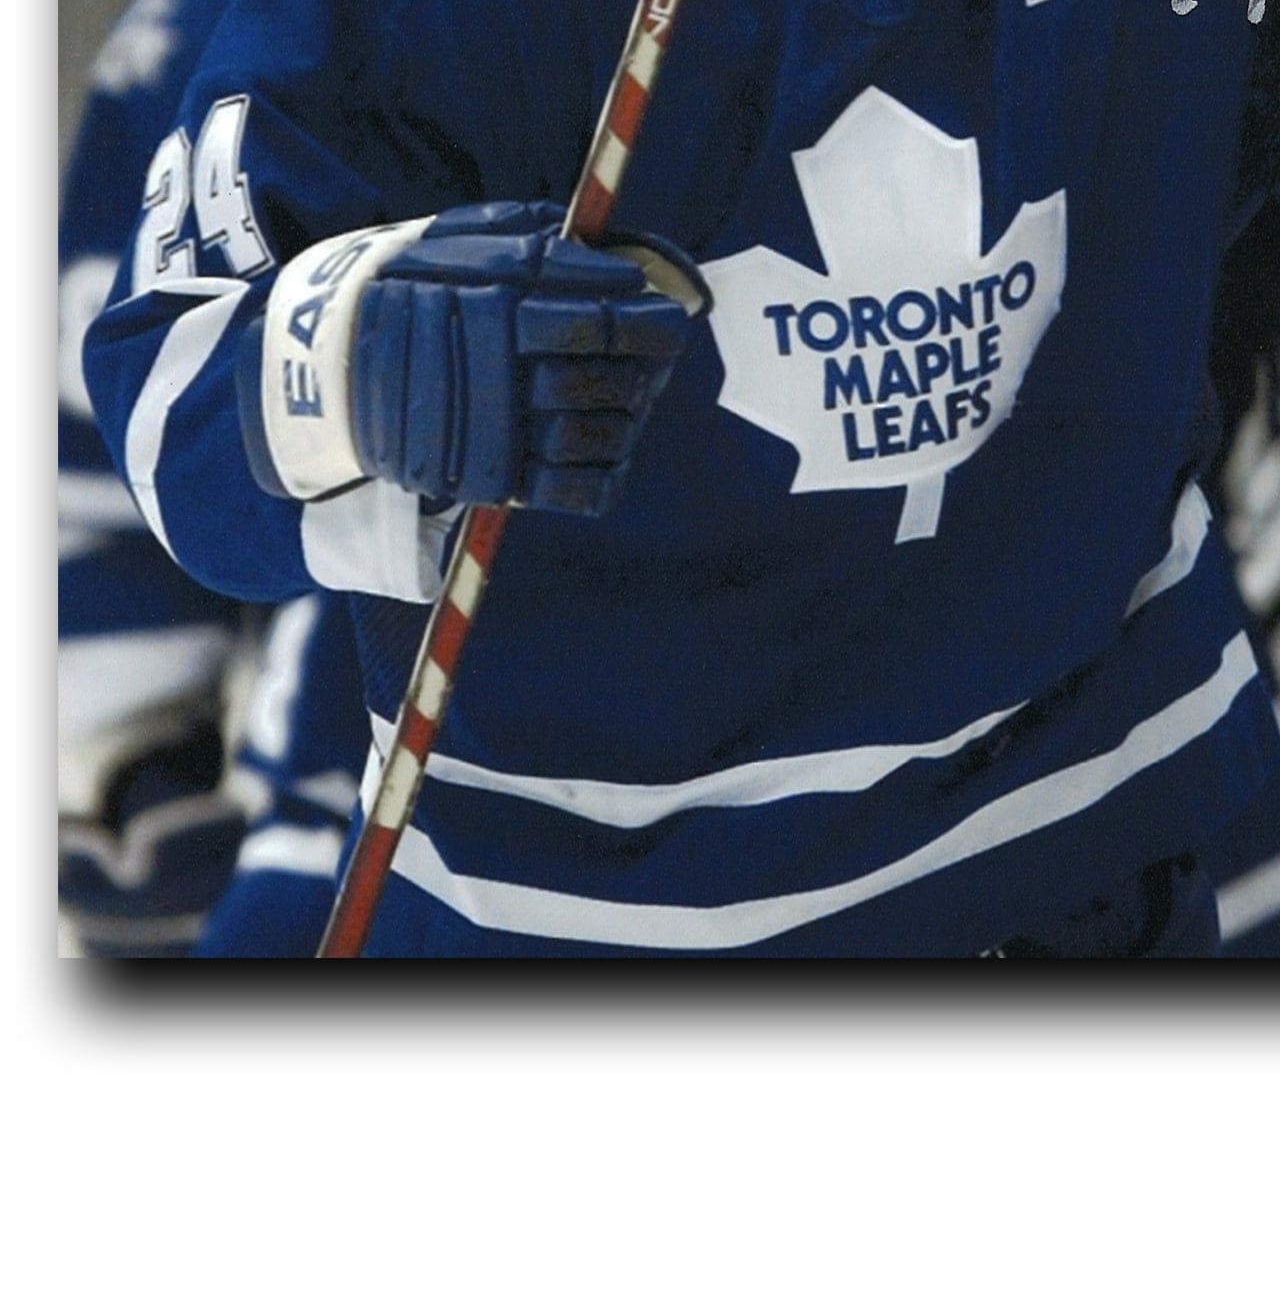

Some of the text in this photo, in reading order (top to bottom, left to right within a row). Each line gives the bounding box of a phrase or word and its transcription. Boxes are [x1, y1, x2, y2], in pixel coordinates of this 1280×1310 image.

[132, 93, 279, 292] 24
[282, 226, 398, 418] EAS
[764, 260, 1036, 357] TORONTO
[823, 325, 1002, 411] MAPLE
[841, 380, 992, 462] LEAFS
